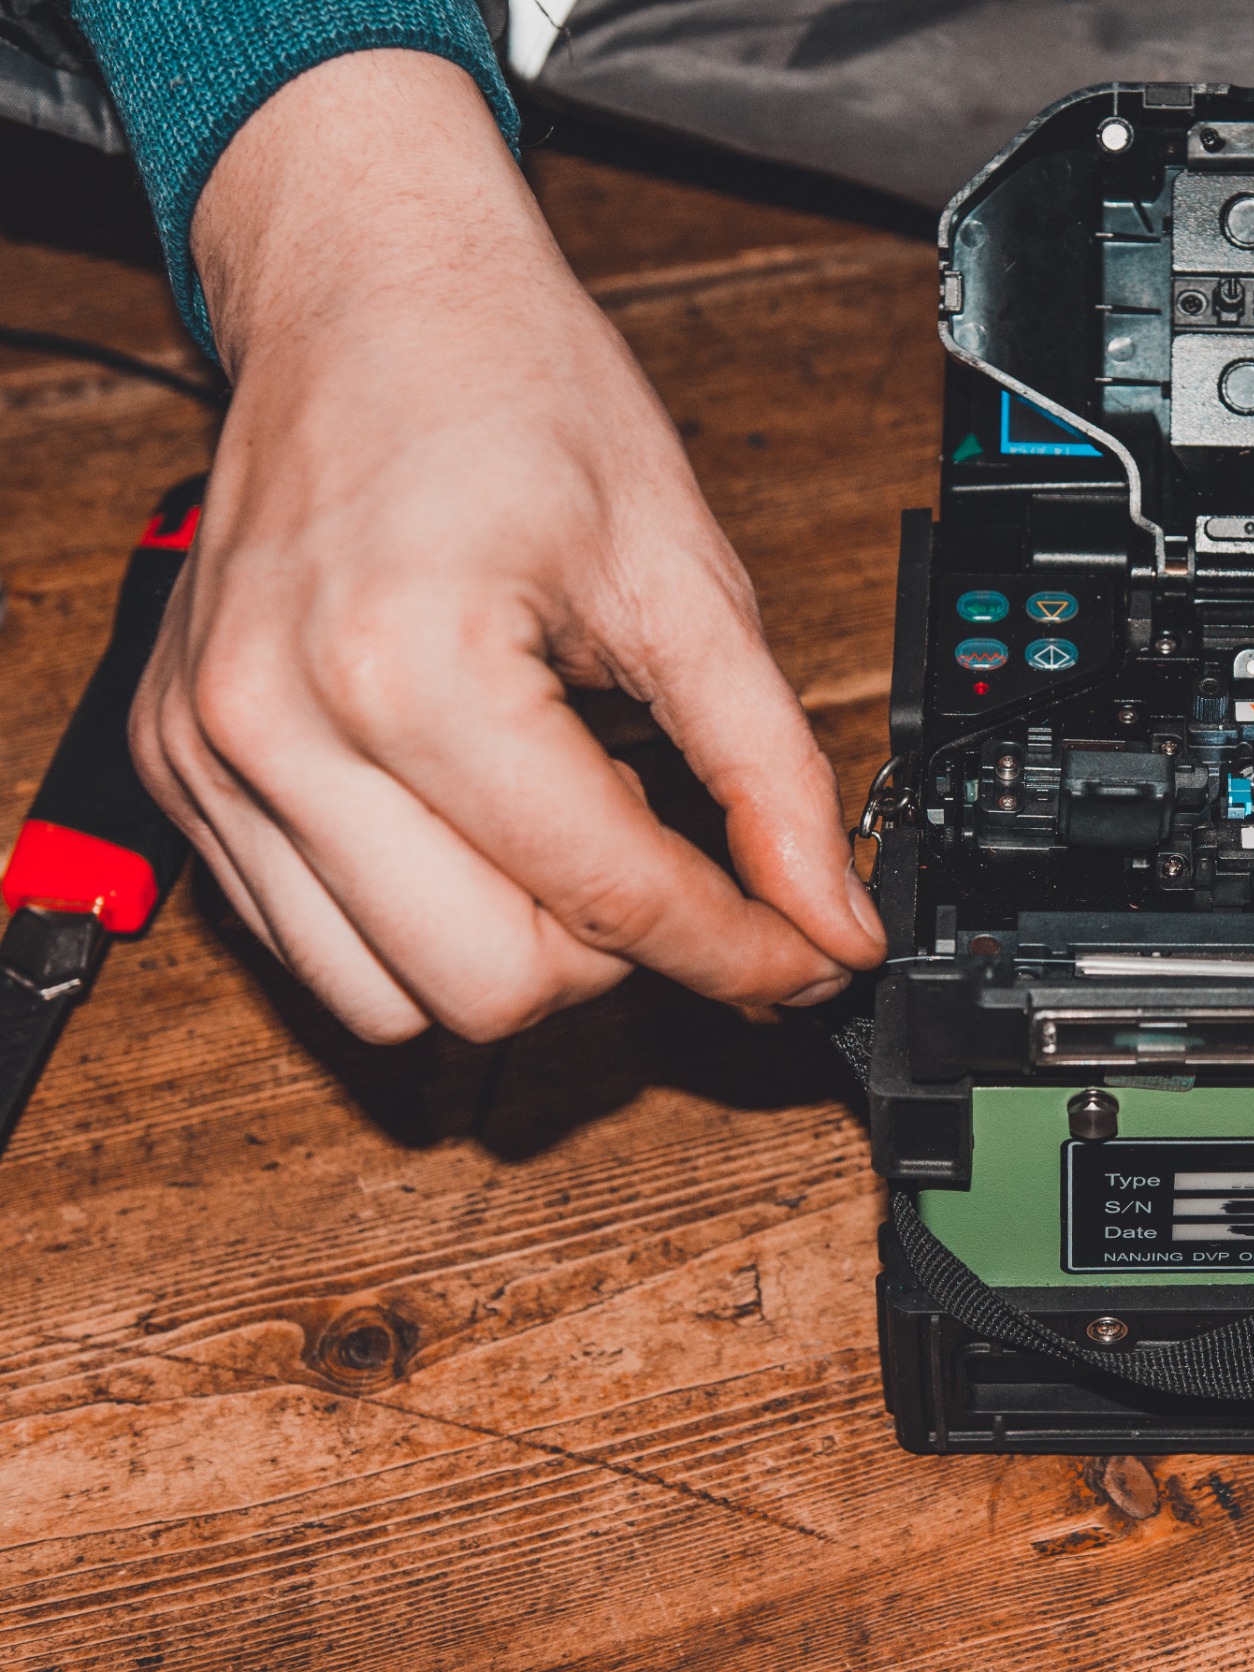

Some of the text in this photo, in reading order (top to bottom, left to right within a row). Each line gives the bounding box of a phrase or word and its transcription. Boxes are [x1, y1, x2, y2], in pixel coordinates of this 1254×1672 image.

[1104, 1173, 1161, 1190] Type
[1104, 1200, 1152, 1214] S/N
[1104, 1226, 1158, 1239] Date
[1104, 1252, 1183, 1262] NANJING
[1192, 1252, 1230, 1262] DVP
